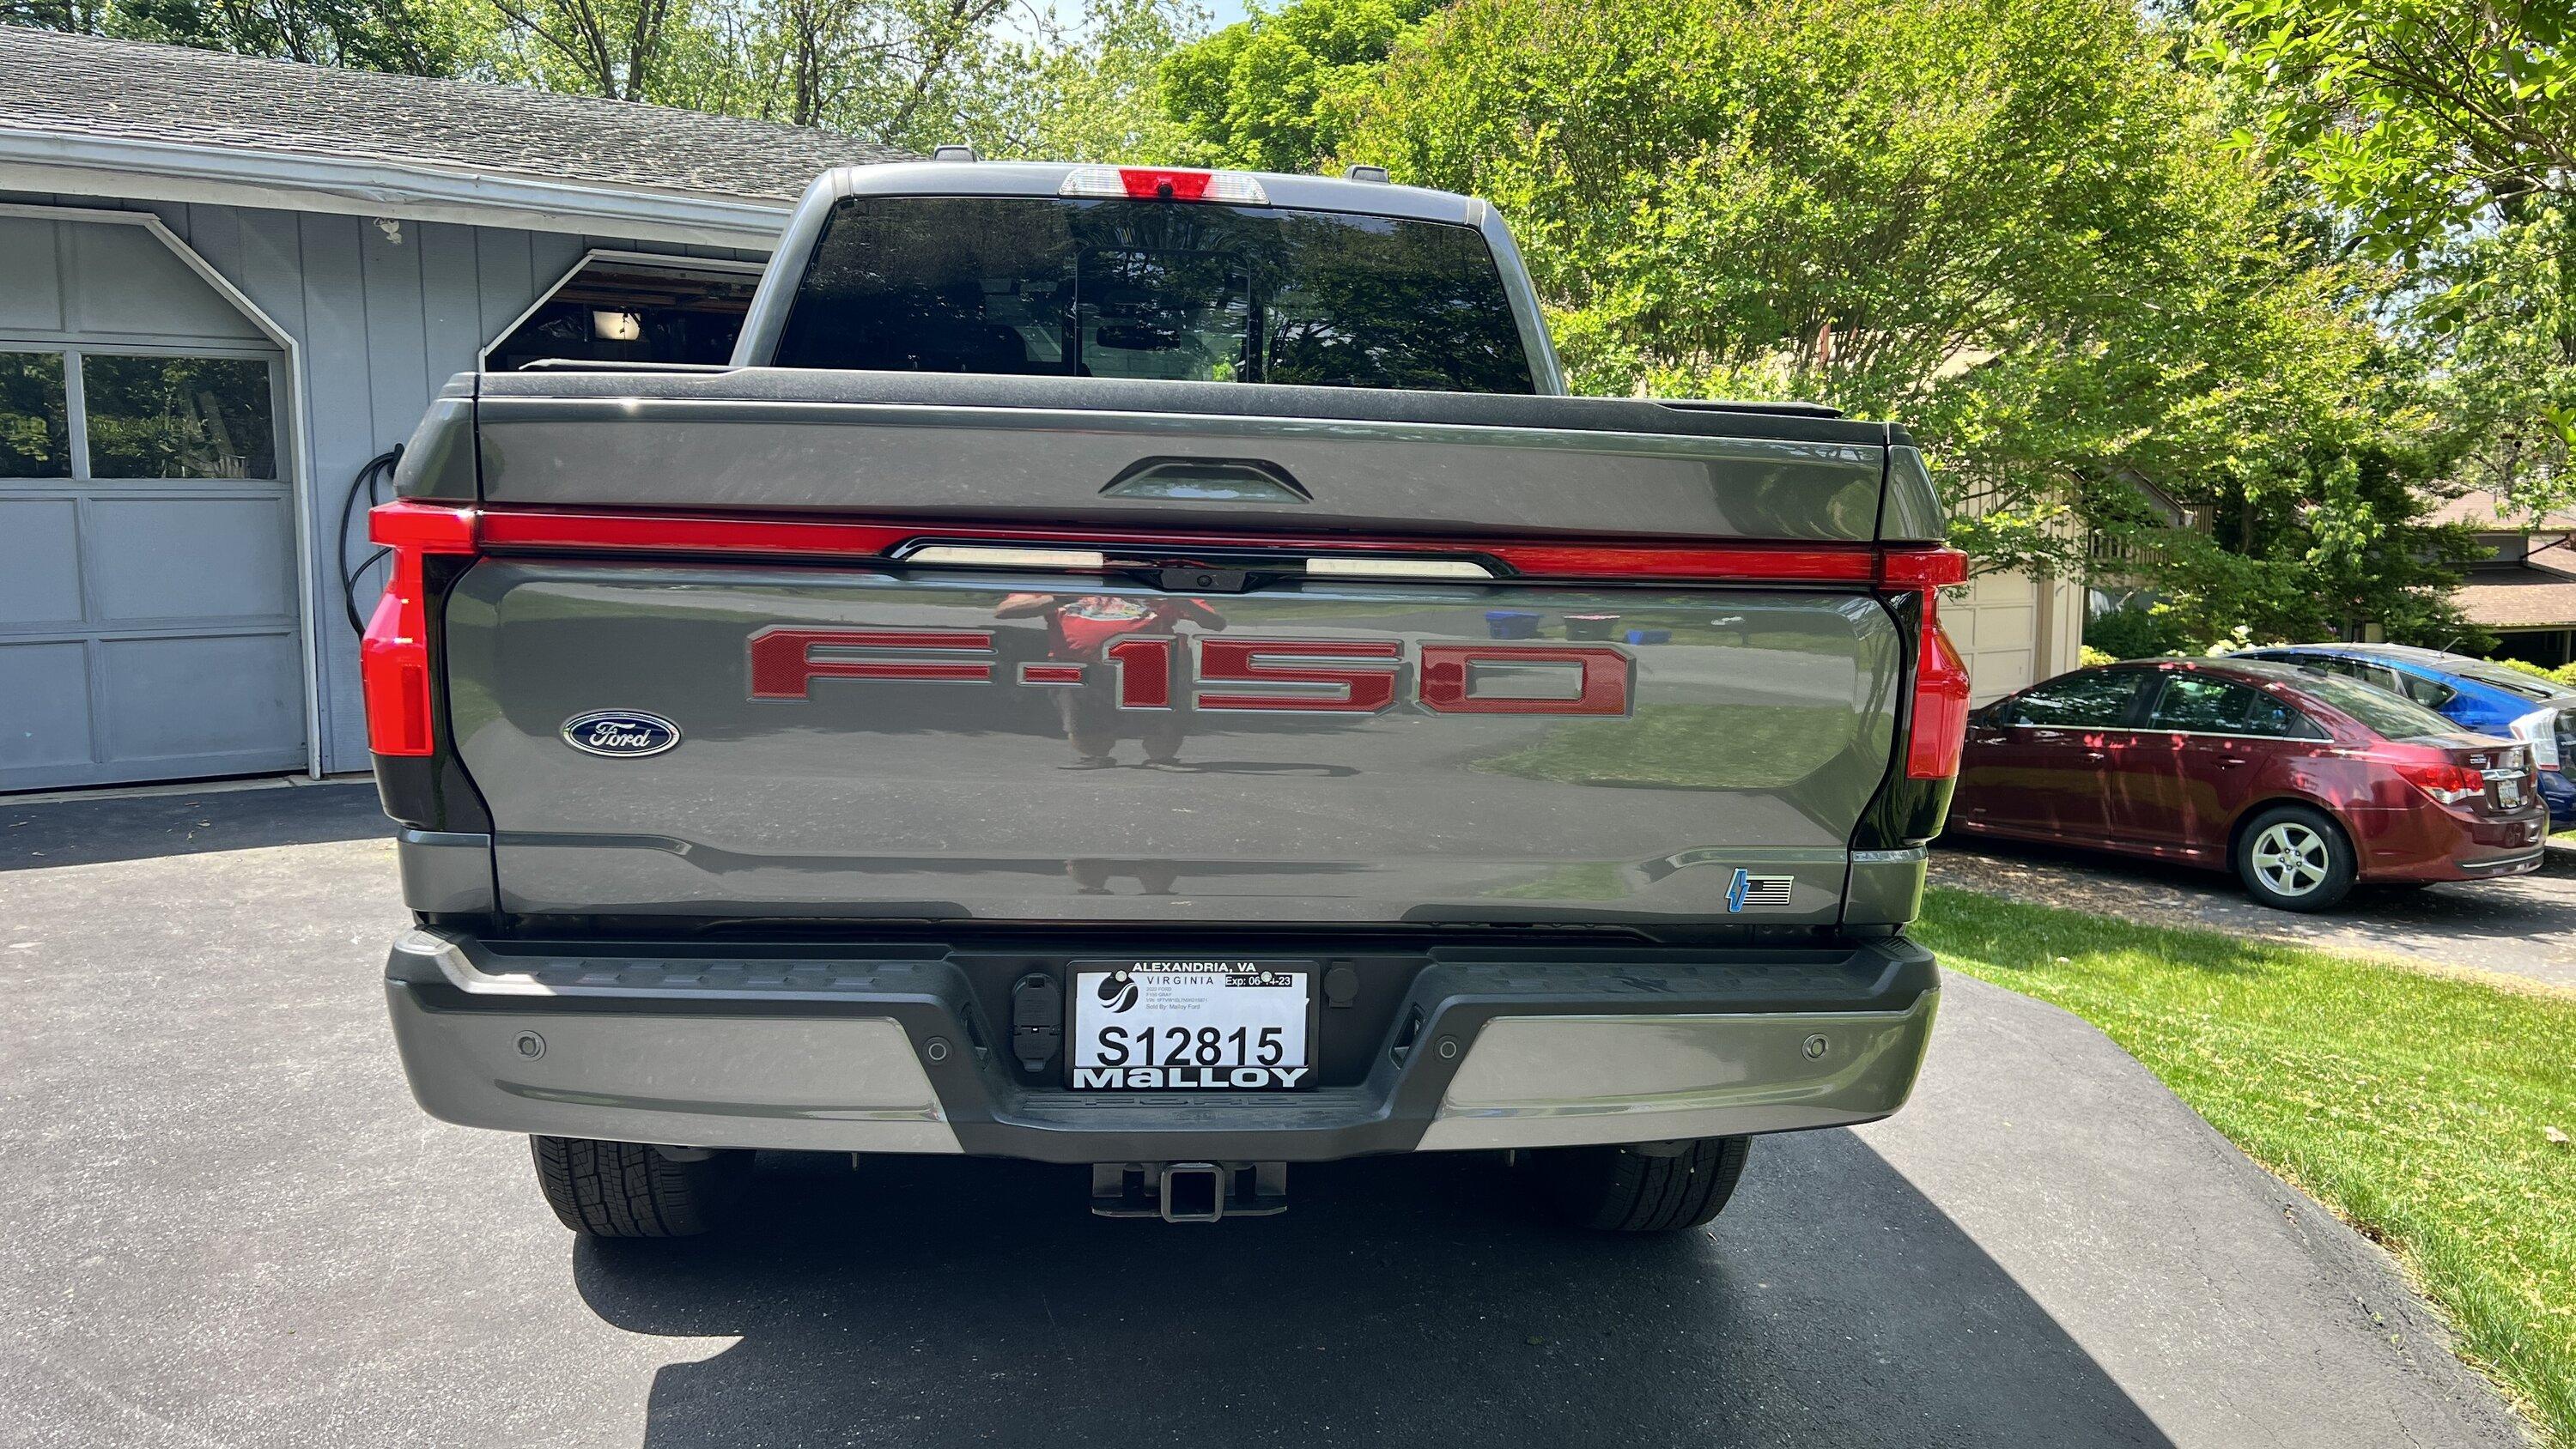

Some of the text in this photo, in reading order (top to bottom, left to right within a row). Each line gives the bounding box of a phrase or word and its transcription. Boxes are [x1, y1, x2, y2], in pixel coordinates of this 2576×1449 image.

[745, 625, 1637, 718] F-150
[589, 721, 652, 747] Ford
[1132, 962, 1256, 974] ALEXANDRIA, VA
[1147, 976, 1214, 985] VIRGINIA
[1225, 976, 1291, 987] Exp: 06-4-23
[1097, 1026, 1284, 1066] S12815
